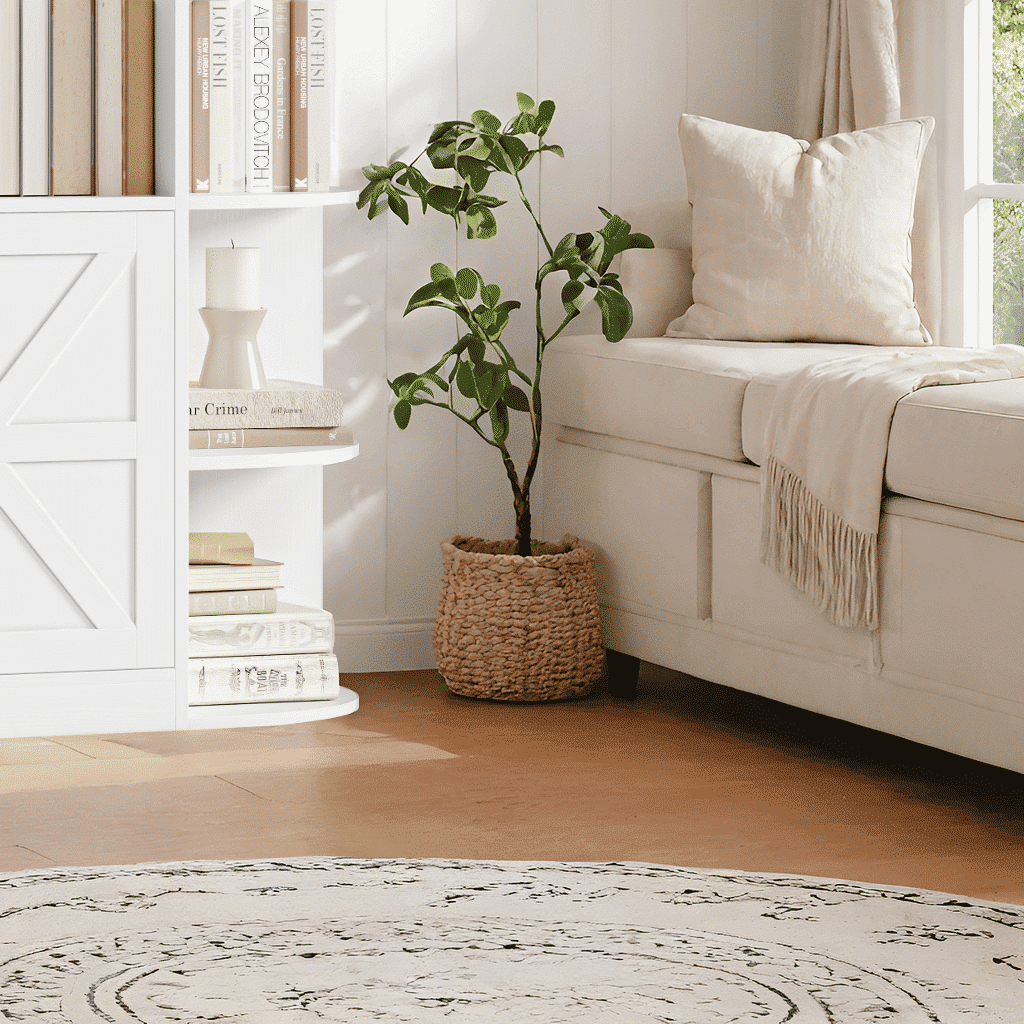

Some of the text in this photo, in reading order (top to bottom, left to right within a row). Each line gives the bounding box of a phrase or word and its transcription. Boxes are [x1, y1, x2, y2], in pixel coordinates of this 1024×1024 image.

[212, 6, 227, 88] LOST FISH
[310, 8, 325, 88] LOST FISH
[253, 4, 270, 180] ALEXEY BRODOVITCH
[276, 57, 287, 140] Gardens in France
[204, 402, 248, 416] Crime
